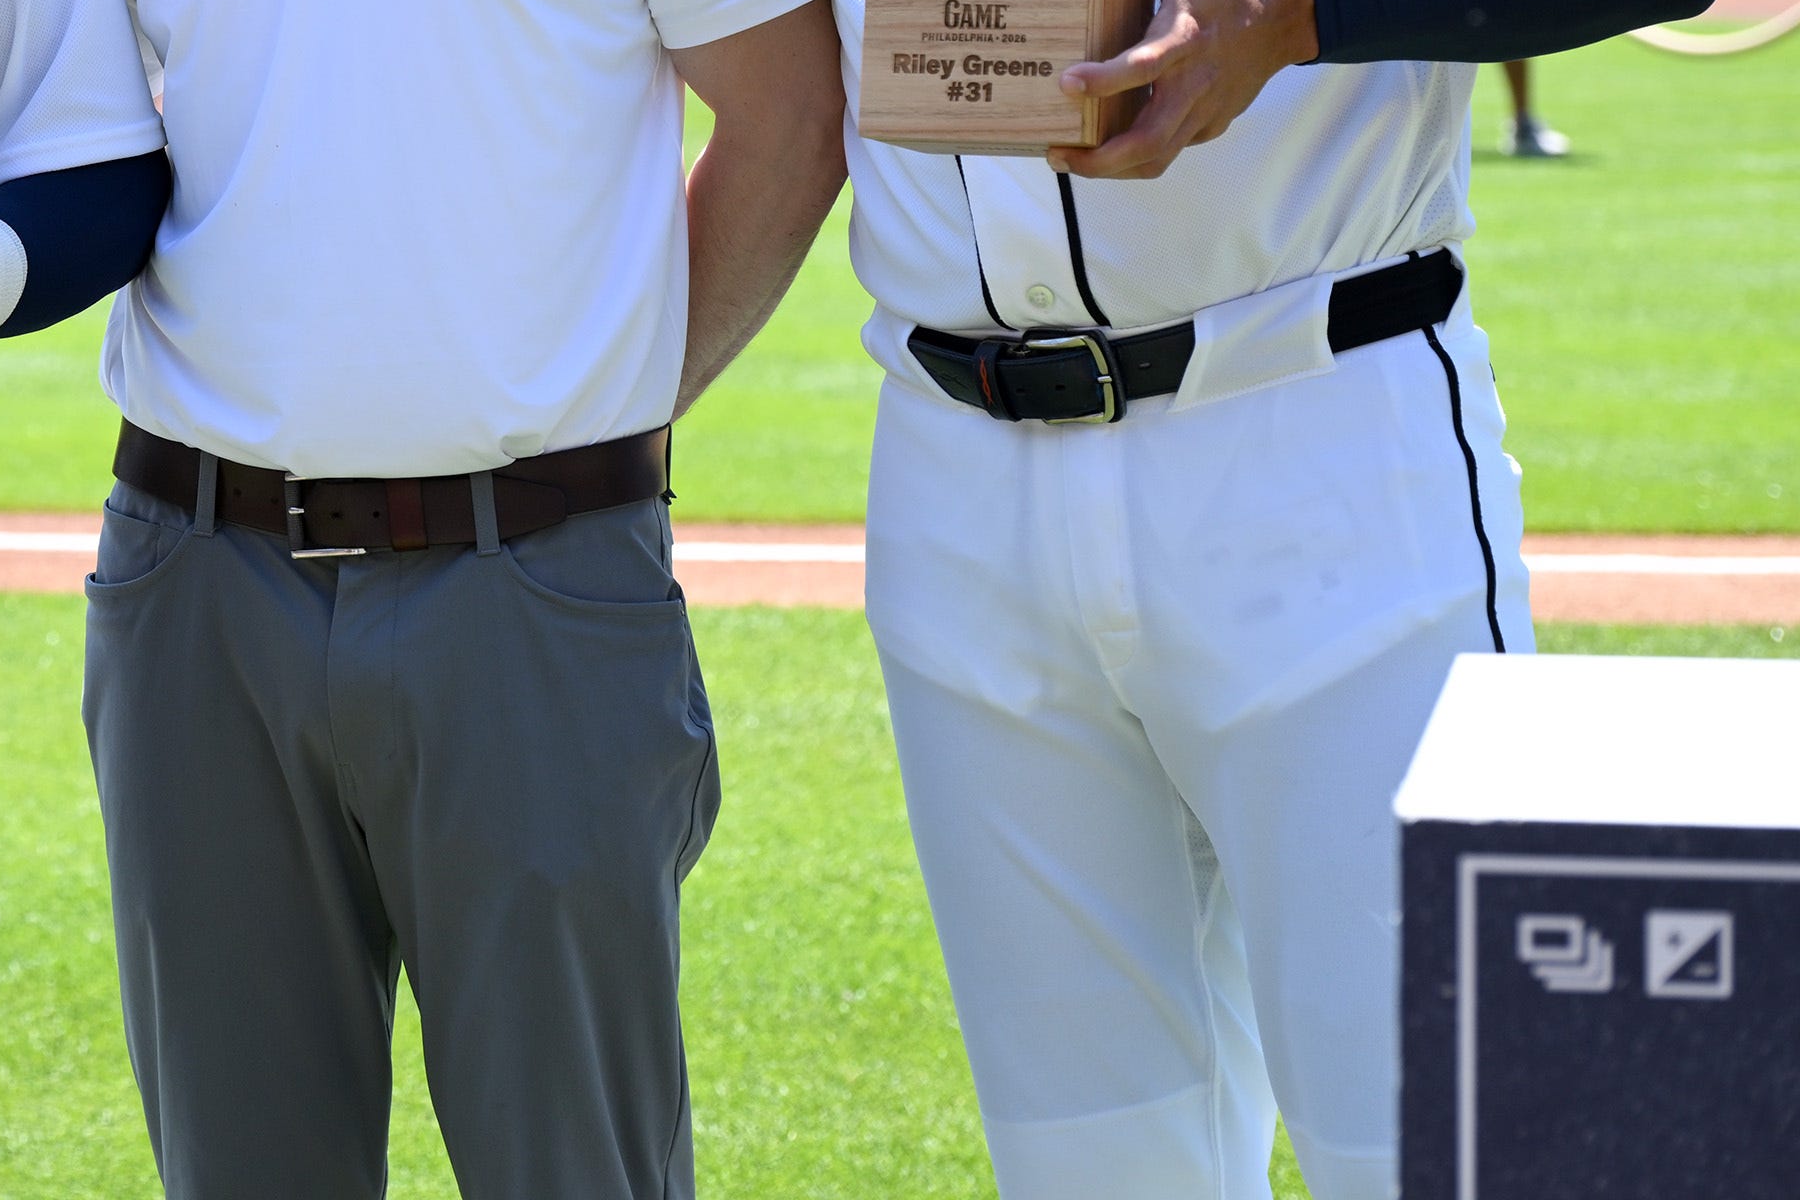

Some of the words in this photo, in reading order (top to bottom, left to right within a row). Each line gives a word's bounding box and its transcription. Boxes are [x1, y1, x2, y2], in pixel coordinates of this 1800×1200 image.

[943, 0, 1011, 31] GAME
[921, 32, 995, 43] PHILADELPHIA
[1001, 33, 1027, 44] 2026
[893, 53, 956, 80] Riley
[962, 54, 1053, 77] Greene
[946, 80, 994, 103] #31
